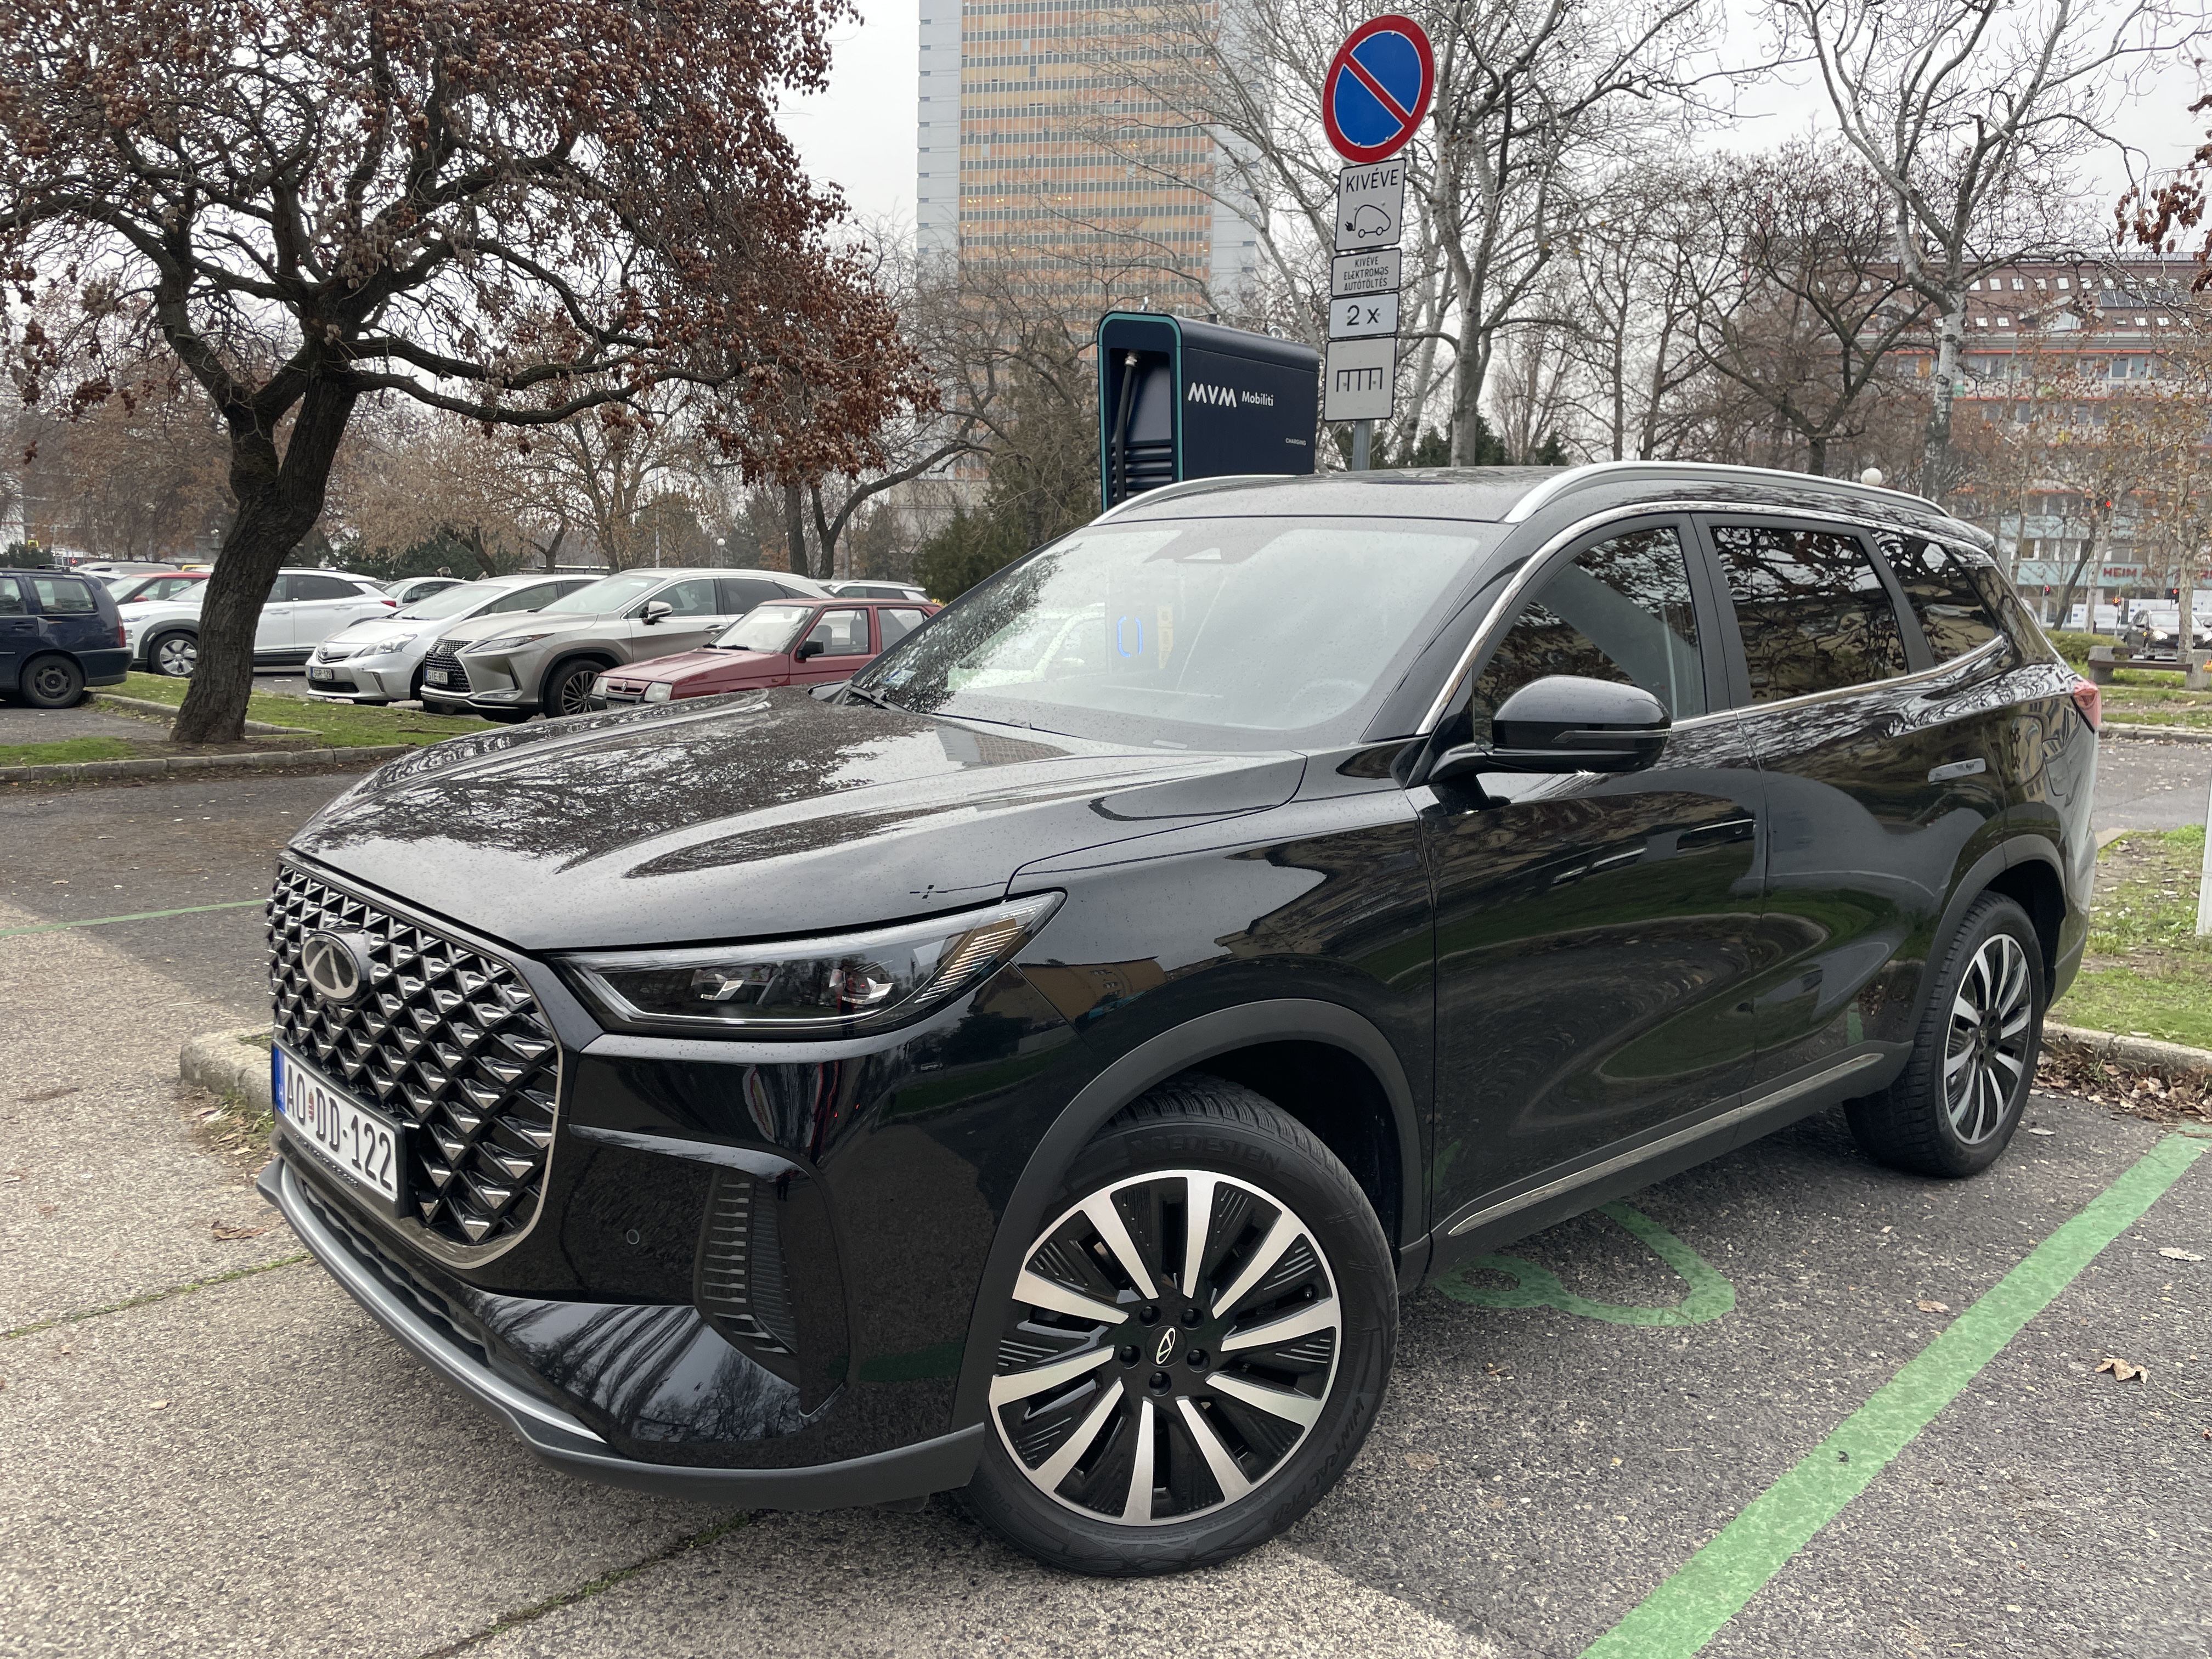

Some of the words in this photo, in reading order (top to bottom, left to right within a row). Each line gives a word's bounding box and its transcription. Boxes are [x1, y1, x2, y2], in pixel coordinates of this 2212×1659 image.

[1346, 167, 1399, 193] KIVÉVE
[1355, 255, 1379, 268] KIVÉVE
[1344, 266, 1389, 280] ELEKTROMOS
[1344, 275, 1387, 291] AUTÓTÖLTÉS
[1347, 304, 1359, 326] 2
[1188, 382, 1237, 408] MVM
[1242, 391, 1274, 407] Mobiliti
[2103, 567, 2138, 577] HEIM
